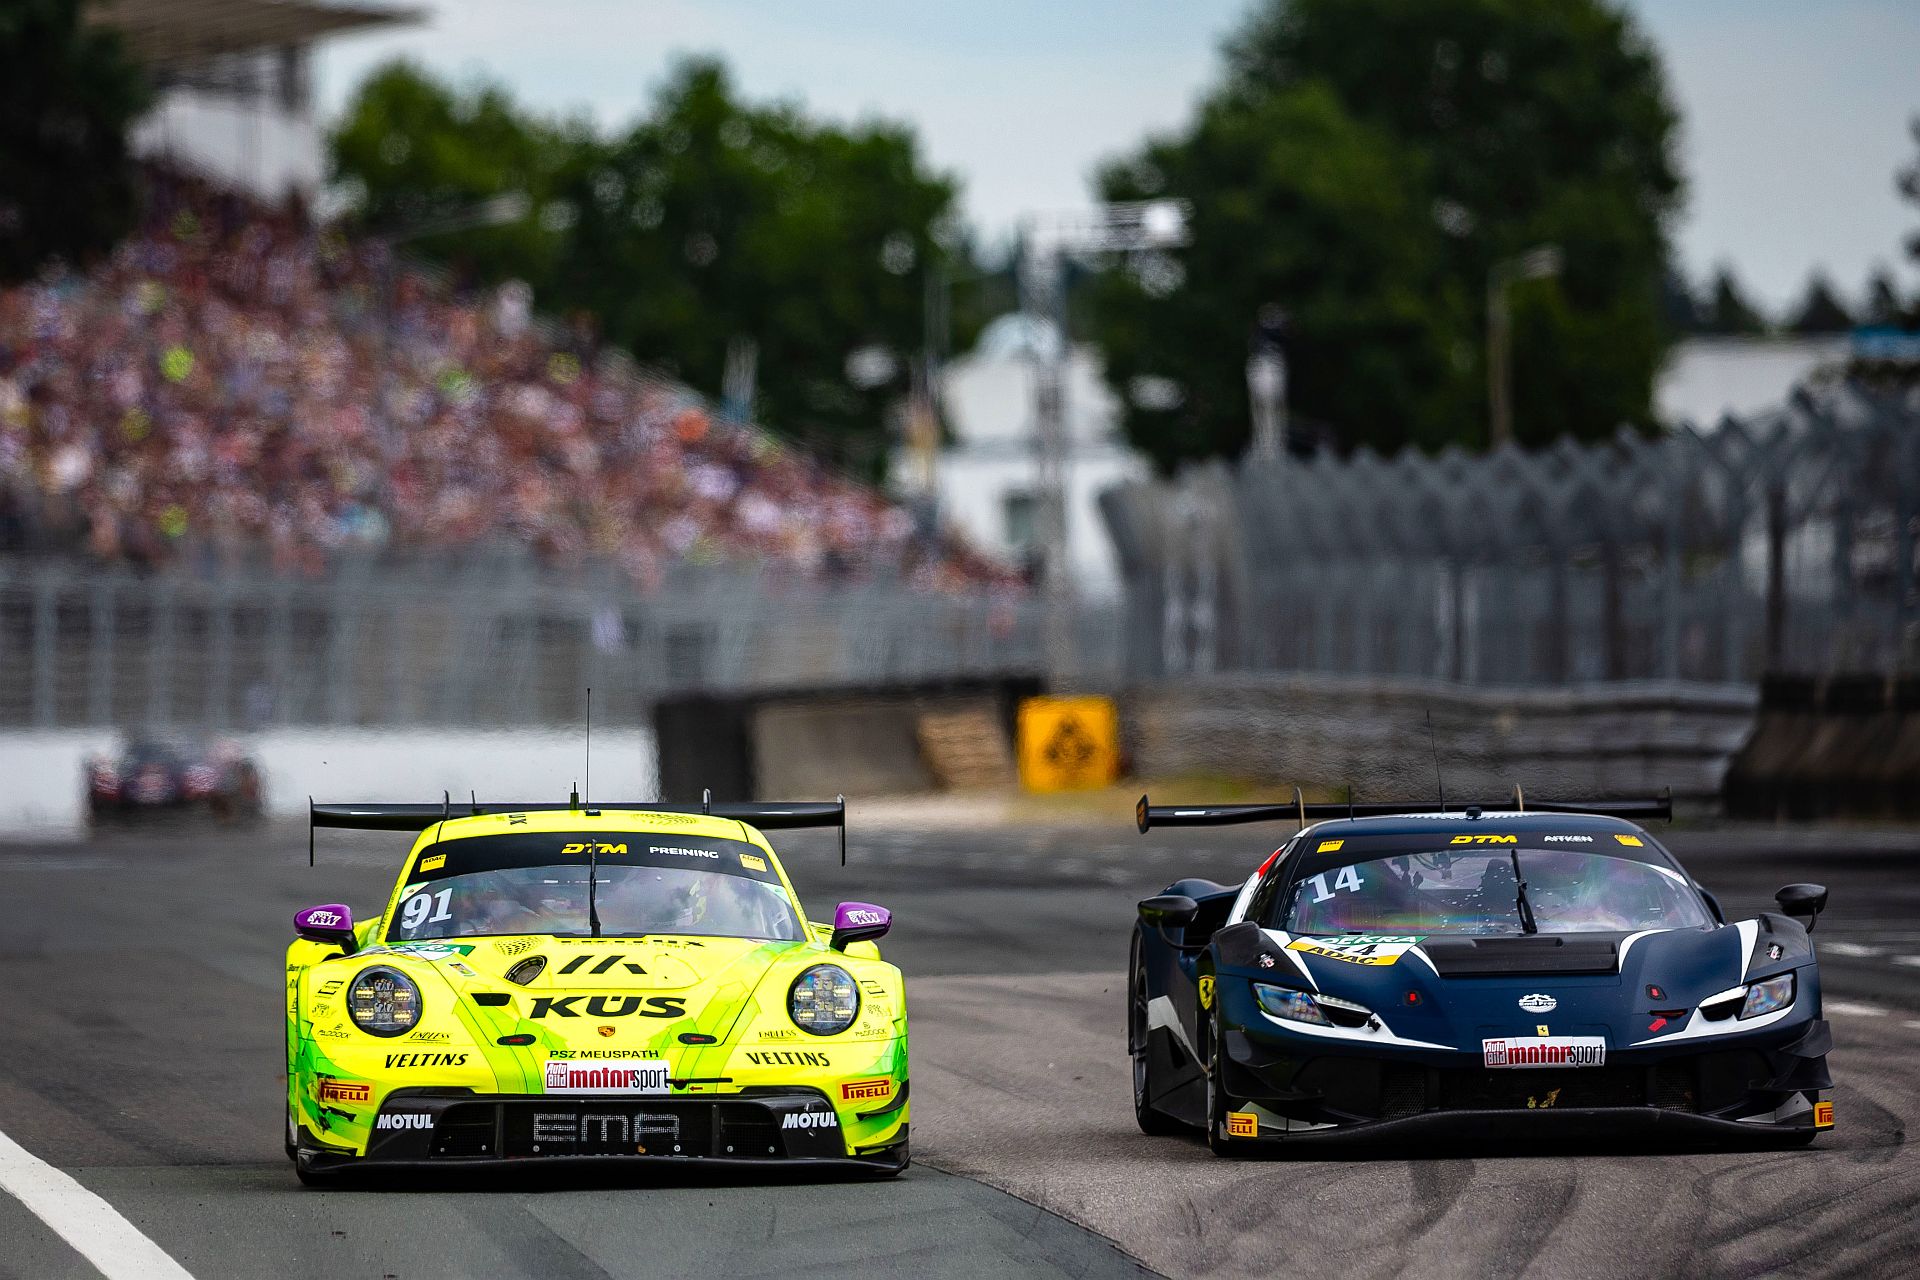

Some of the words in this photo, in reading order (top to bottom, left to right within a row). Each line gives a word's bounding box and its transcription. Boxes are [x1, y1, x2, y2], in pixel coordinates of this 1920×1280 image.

[1450, 835, 1518, 844] DTM
[1544, 835, 1594, 843] AITKEN
[561, 843, 628, 854] DTM
[649, 846, 719, 859] PREINING
[1308, 865, 1364, 903] 14
[402, 887, 453, 929] 91
[1318, 935, 1416, 945] DEKRA
[1306, 946, 1378, 965] ADAC
[530, 996, 686, 1018] KÜS
[1486, 1041, 1505, 1052] Auto
[385, 1053, 469, 1068] VELTINS
[549, 1050, 577, 1058] PSZ
[580, 1050, 659, 1058] MEUSPATH
[746, 1052, 830, 1066] VELTINS
[1488, 1052, 1505, 1064] Bild
[547, 1063, 567, 1074] Auto
[548, 1074, 566, 1087] Bild
[320, 1081, 370, 1101] PIRELLI
[841, 1079, 890, 1100] PIRELLI
[376, 1114, 434, 1129] MOTUL
[782, 1111, 837, 1129] MOTUL
